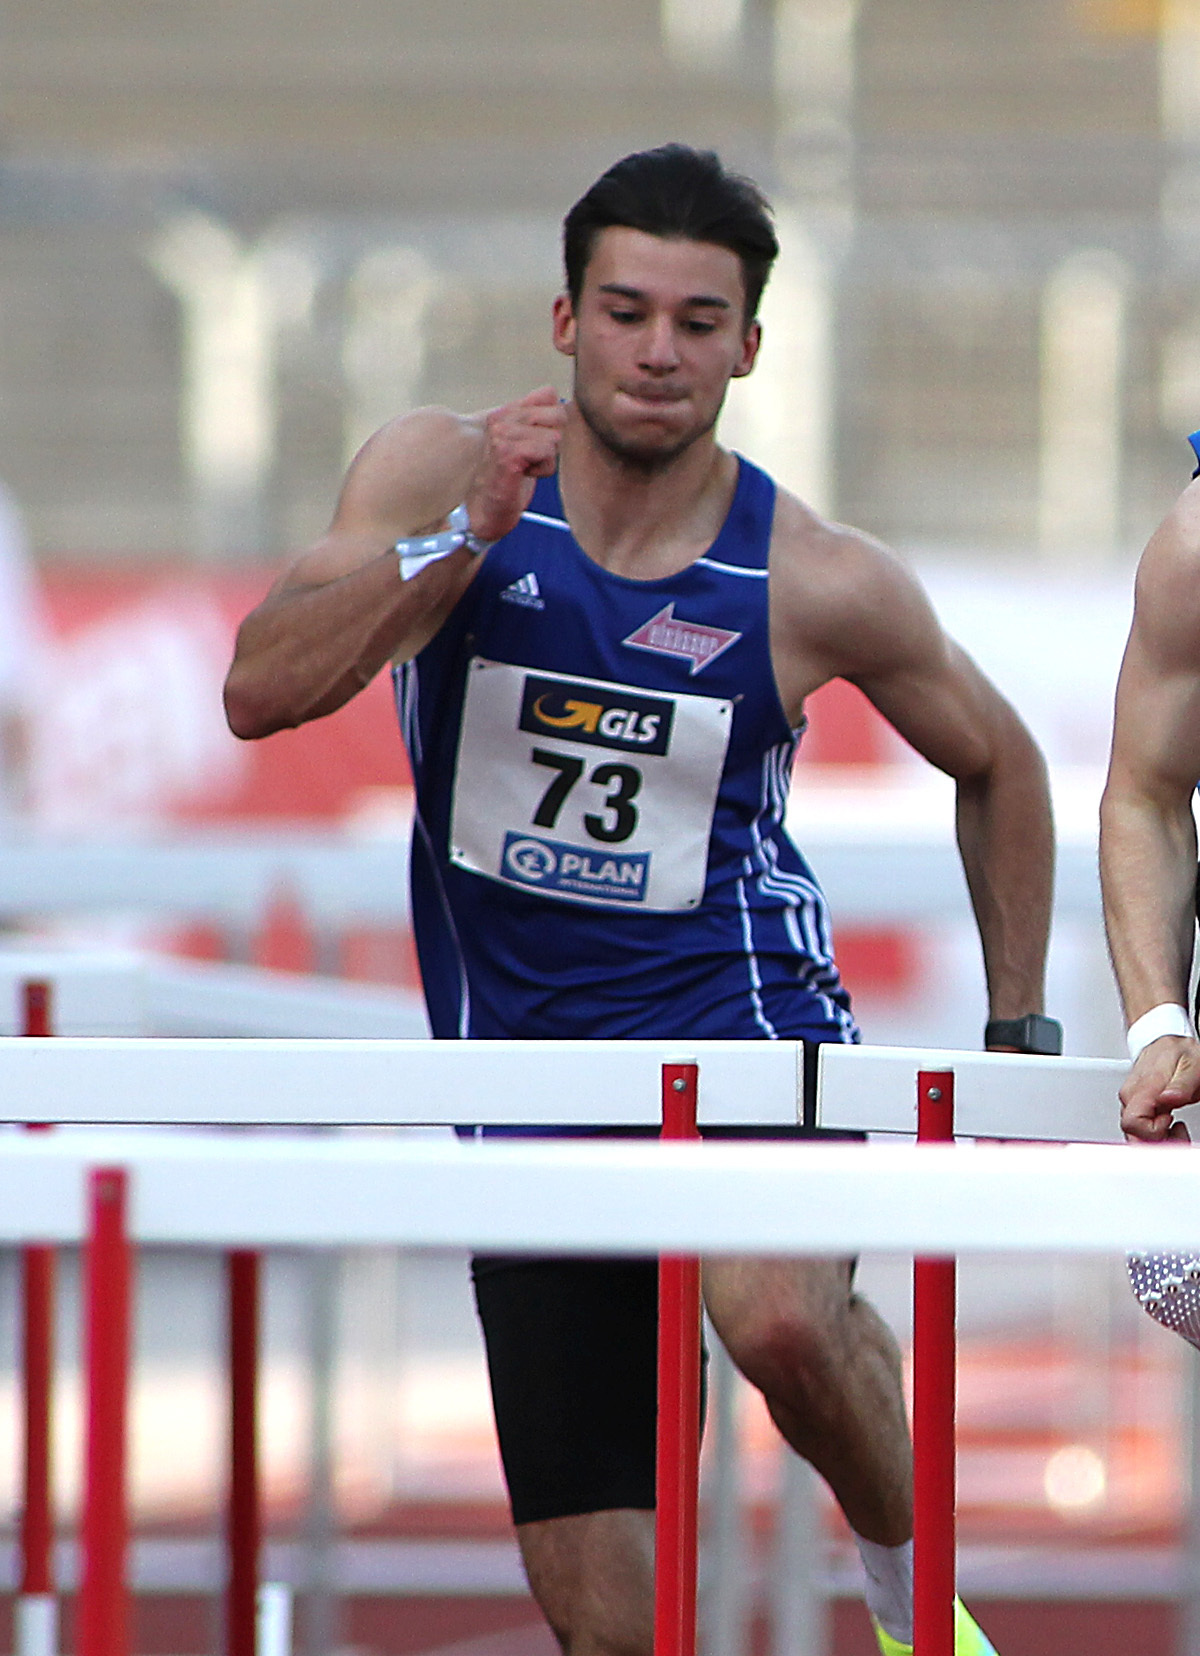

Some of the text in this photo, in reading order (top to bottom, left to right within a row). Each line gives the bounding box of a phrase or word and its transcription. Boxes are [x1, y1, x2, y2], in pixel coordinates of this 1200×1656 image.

[600, 707, 661, 744] GLS
[531, 748, 643, 843] 73
[560, 853, 644, 885] PLAN
